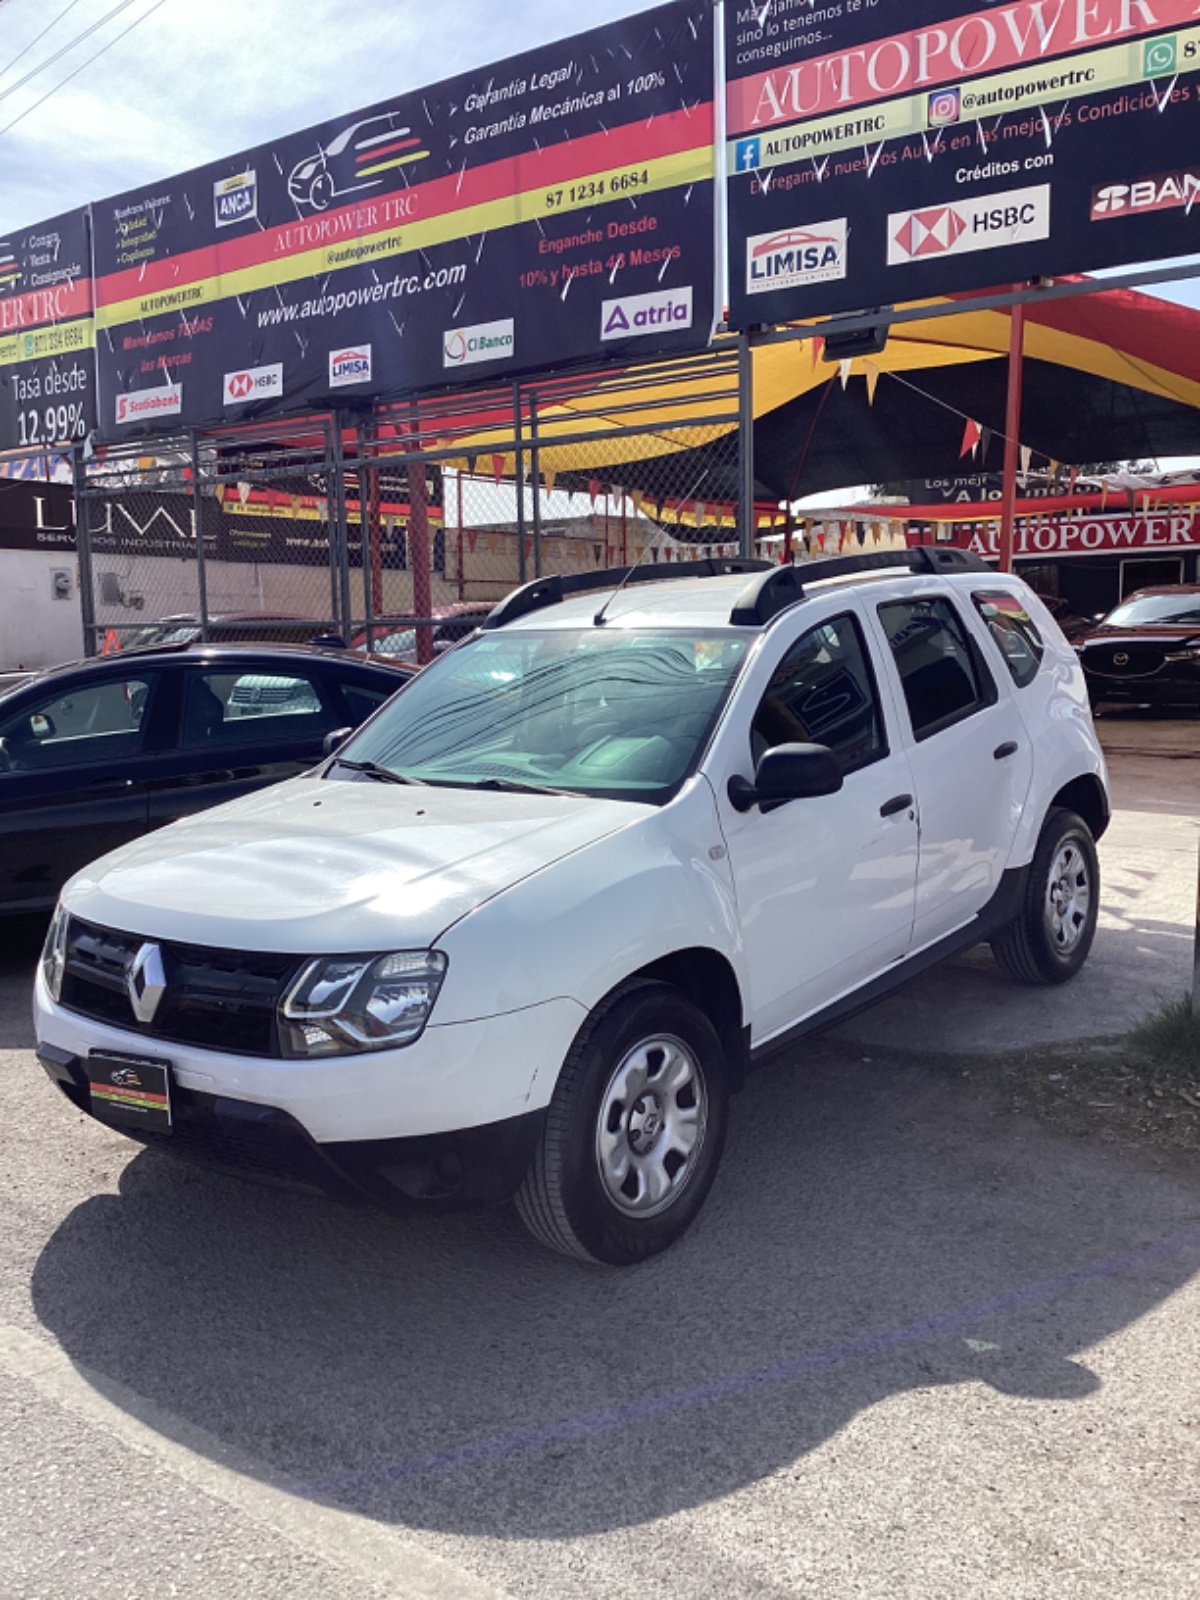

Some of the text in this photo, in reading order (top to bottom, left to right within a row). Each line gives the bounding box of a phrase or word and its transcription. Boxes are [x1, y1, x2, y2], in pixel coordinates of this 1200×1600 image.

[736, 28, 763, 46] sino
[766, 22, 779, 36] lo
[783, 8, 842, 32] tenemos
[847, 0, 861, 12] te
[751, 0, 1159, 125] AUTOPOWER
[1184, 40, 1200, 59] 8
[464, 60, 574, 113] Garantía Legal
[962, 66, 1095, 109] @autopowertrc
[464, 70, 666, 145] Garantía Mecánica al 100%
[765, 115, 885, 156] AUTOPOWERTRC
[951, 135, 971, 150] en
[976, 126, 998, 144] las
[1002, 112, 1072, 142] mejores
[955, 152, 1054, 184] Créditos con
[220, 189, 251, 214] ANCA
[546, 169, 649, 208] 87 1234 6684
[274, 193, 419, 253] AUTOPOWER TRC
[538, 215, 658, 254] Enganche Desde
[973, 203, 1035, 234] HSBC
[326, 235, 403, 265] @autopowertrc
[519, 244, 682, 289] 10% y hasta 48 Meses
[750, 245, 838, 279] LIMISA
[28, 287, 69, 321] TRC
[257, 263, 467, 328] www.autopowertrc.com
[633, 301, 688, 327] atria
[11, 362, 87, 401] Tasa desde
[254, 374, 278, 388] HSBC
[332, 360, 369, 377] LIMISA
[129, 393, 179, 413] Scotiabank
[18, 401, 86, 446] 12.99%
[925, 478, 949, 489] Los
[966, 517, 1194, 554] AUTOPOWER
